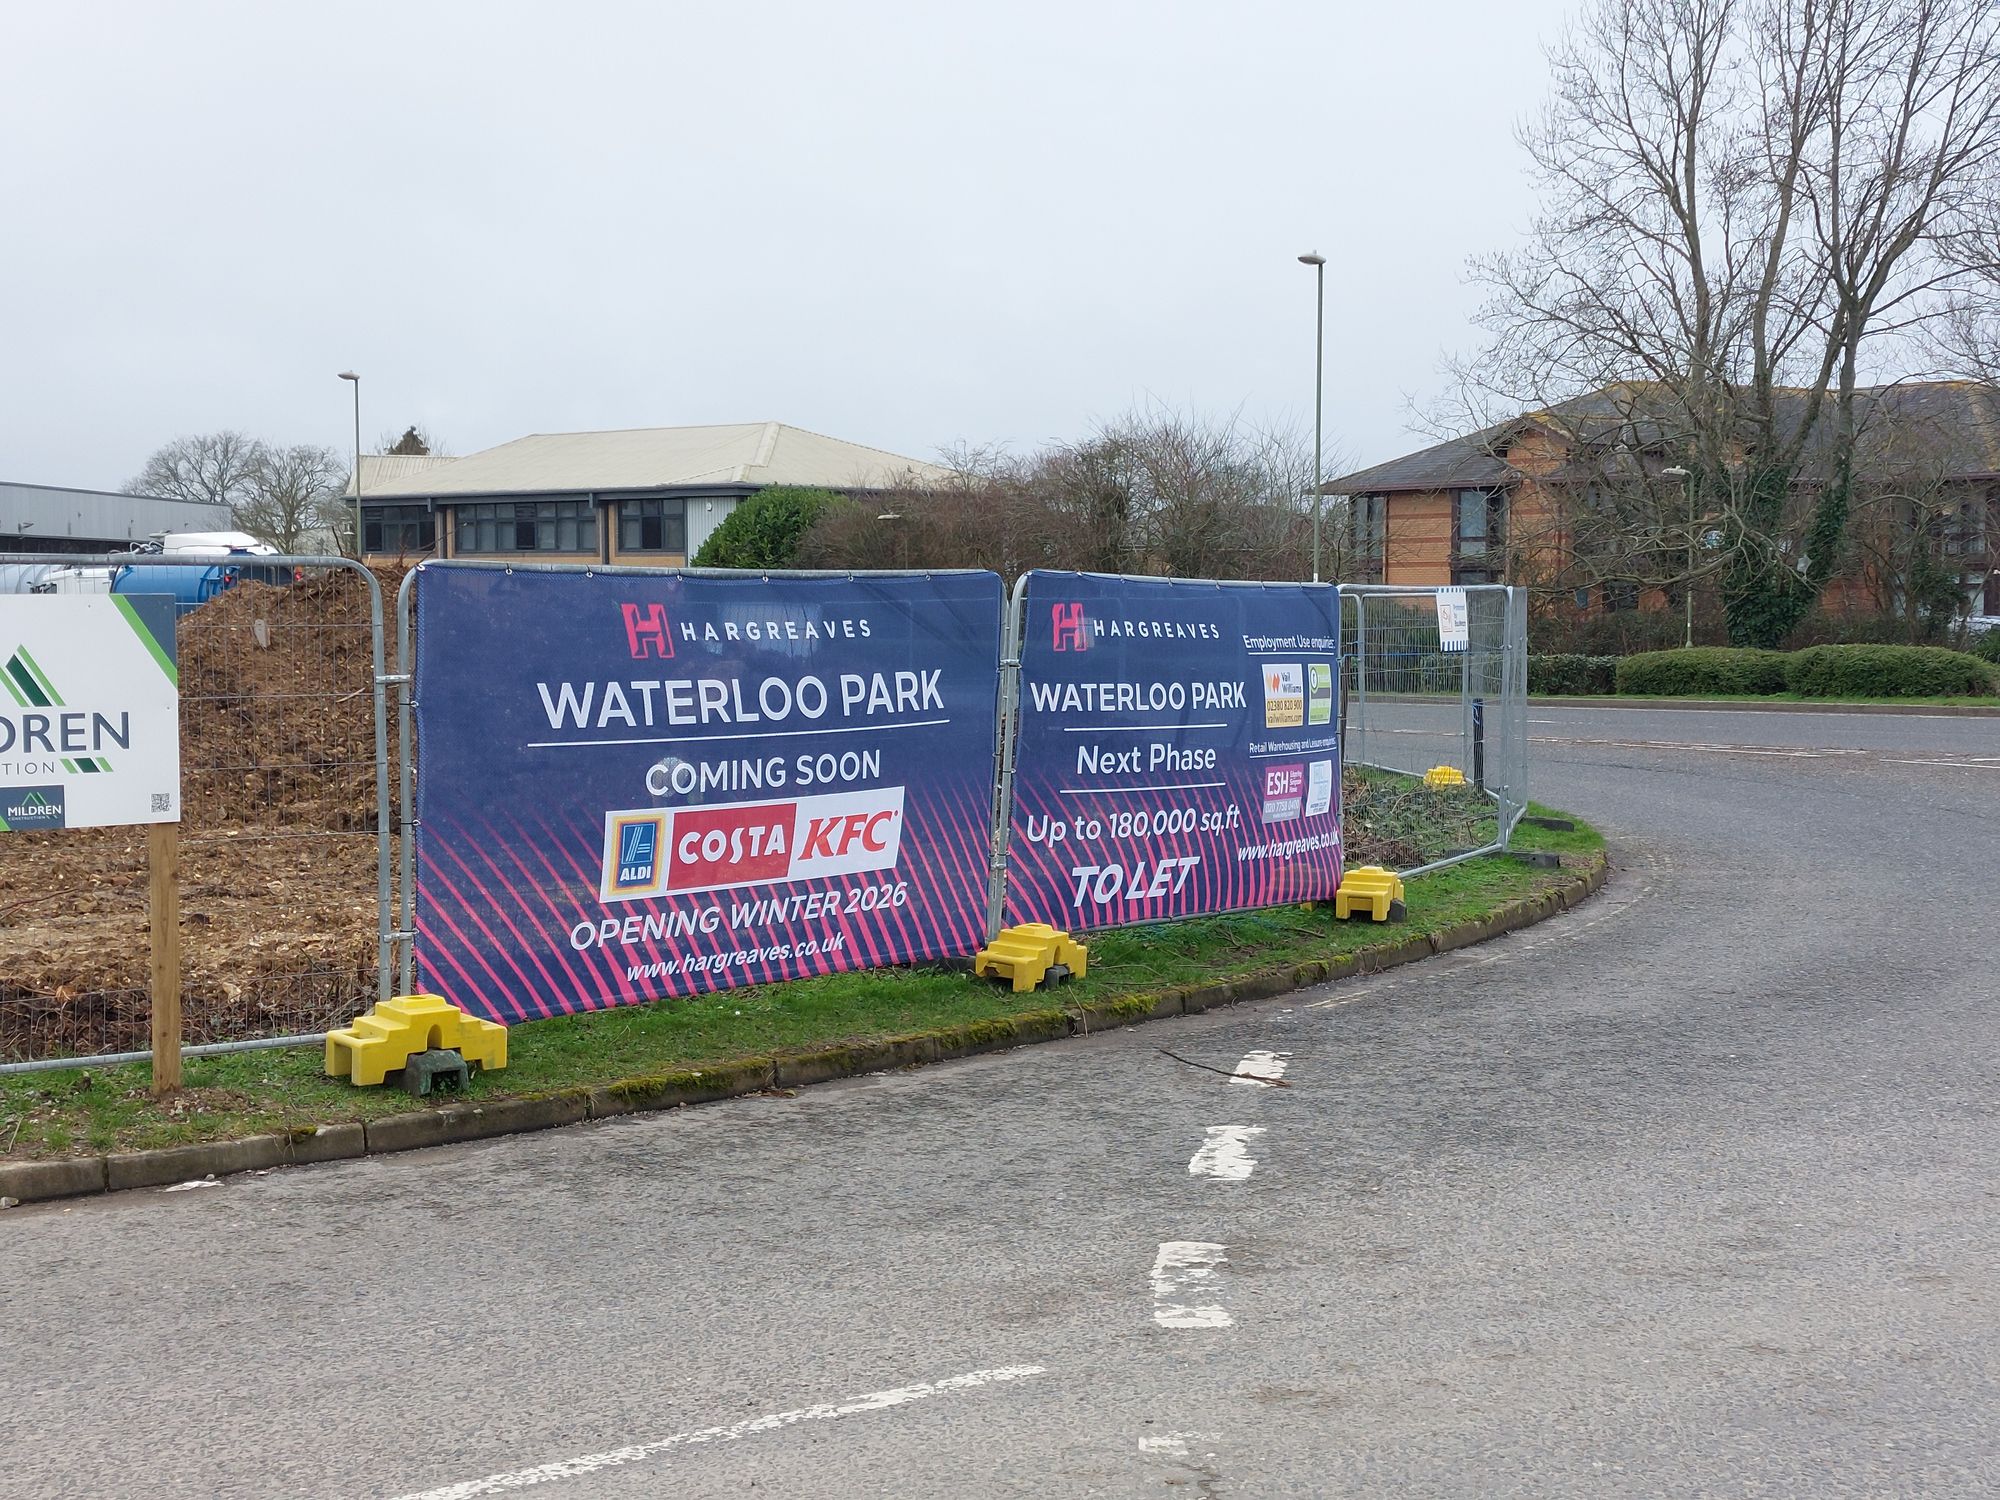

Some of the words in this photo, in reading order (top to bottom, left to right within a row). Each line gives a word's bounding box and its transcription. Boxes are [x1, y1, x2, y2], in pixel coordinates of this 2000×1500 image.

[680, 619, 872, 642] HARGREAVES
[1093, 619, 1220, 639] HARGREAVES
[1242, 634, 1297, 652] Employment
[1297, 634, 1311, 648] Use
[537, 675, 828, 729] WATERLOO
[839, 668, 945, 717] PARK
[1030, 681, 1186, 712] WATERLOO
[1192, 681, 1247, 710] PARK
[1076, 745, 1142, 775] Next
[1149, 743, 1217, 772] Phase
[1249, 741, 1268, 753] Retail
[1268, 739, 1301, 752] Warehousing
[645, 756, 786, 796] COMING
[796, 749, 880, 786] SOON
[1266, 771, 1289, 796] ESH
[7, 804, 62, 817] MILDREN
[1026, 815, 1067, 848] Up
[1075, 815, 1101, 841] to
[1109, 807, 1196, 841] 180,000
[1199, 804, 1240, 839] sq.ft
[678, 823, 786, 865] COSTA
[798, 810, 893, 861] KFC
[1238, 826, 1340, 861] www.hargreaves.co.uk
[619, 865, 652, 882] ALDI
[1071, 863, 1124, 907] TO
[1124, 856, 1201, 900] LET
[570, 906, 720, 951] OPENING
[730, 891, 838, 929] WINTER
[844, 881, 908, 914] 2026
[626, 932, 847, 981] www.hargreaves.co.uk
